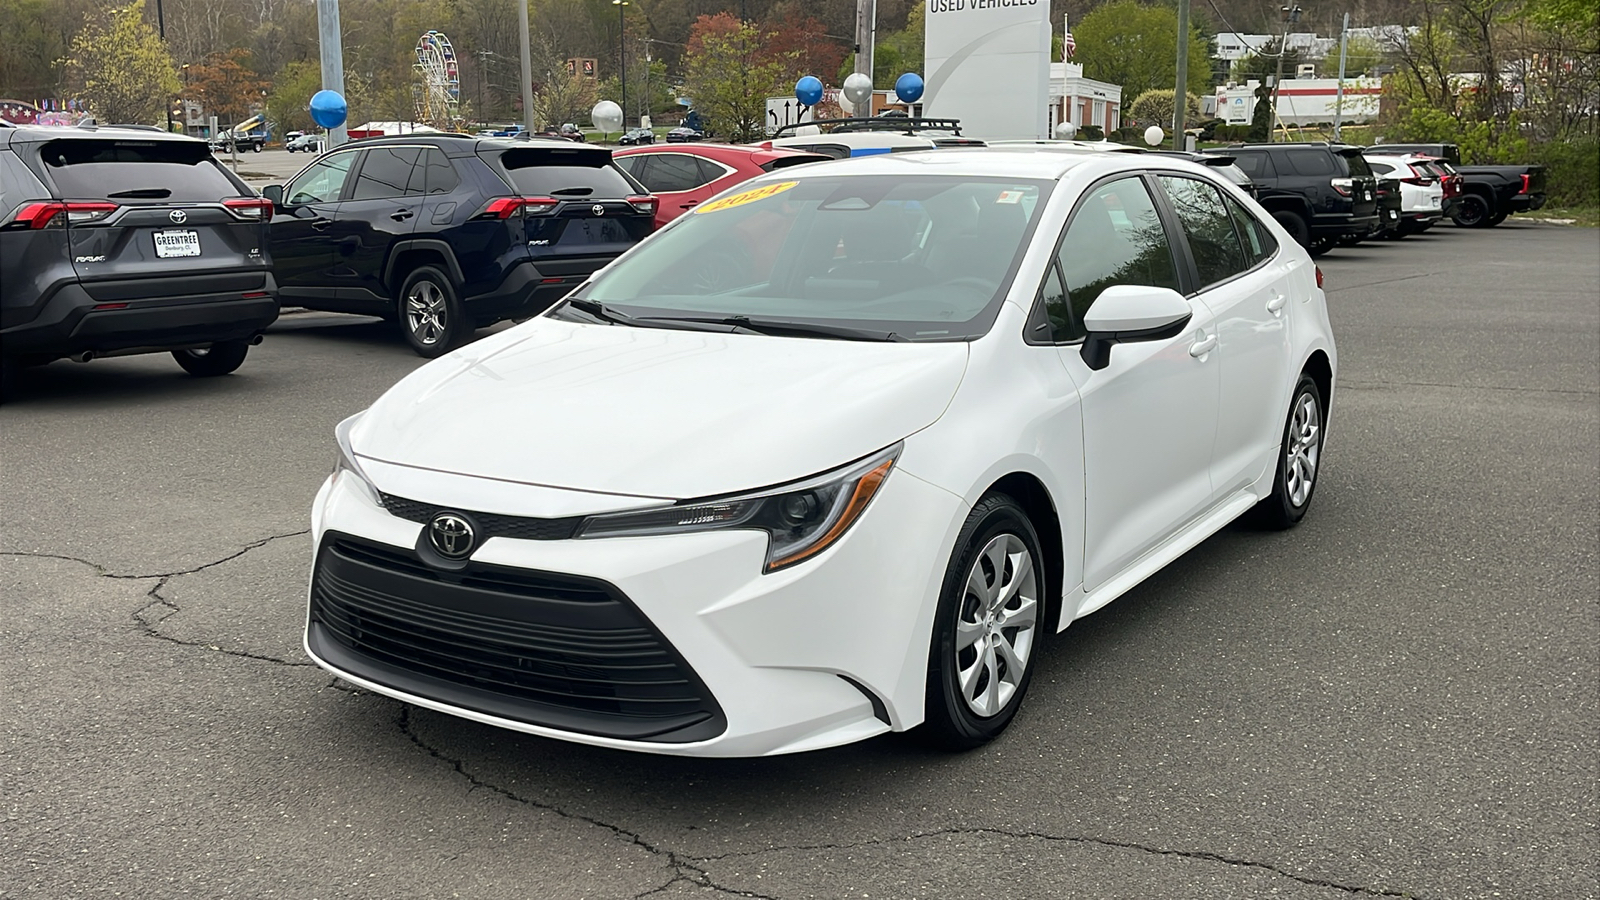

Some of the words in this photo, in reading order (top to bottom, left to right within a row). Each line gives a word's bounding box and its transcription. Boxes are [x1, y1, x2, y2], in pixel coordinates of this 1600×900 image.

[930, 0, 965, 13] USED
[710, 184, 791, 211] 2024
[156, 234, 197, 246] GREENTREE
